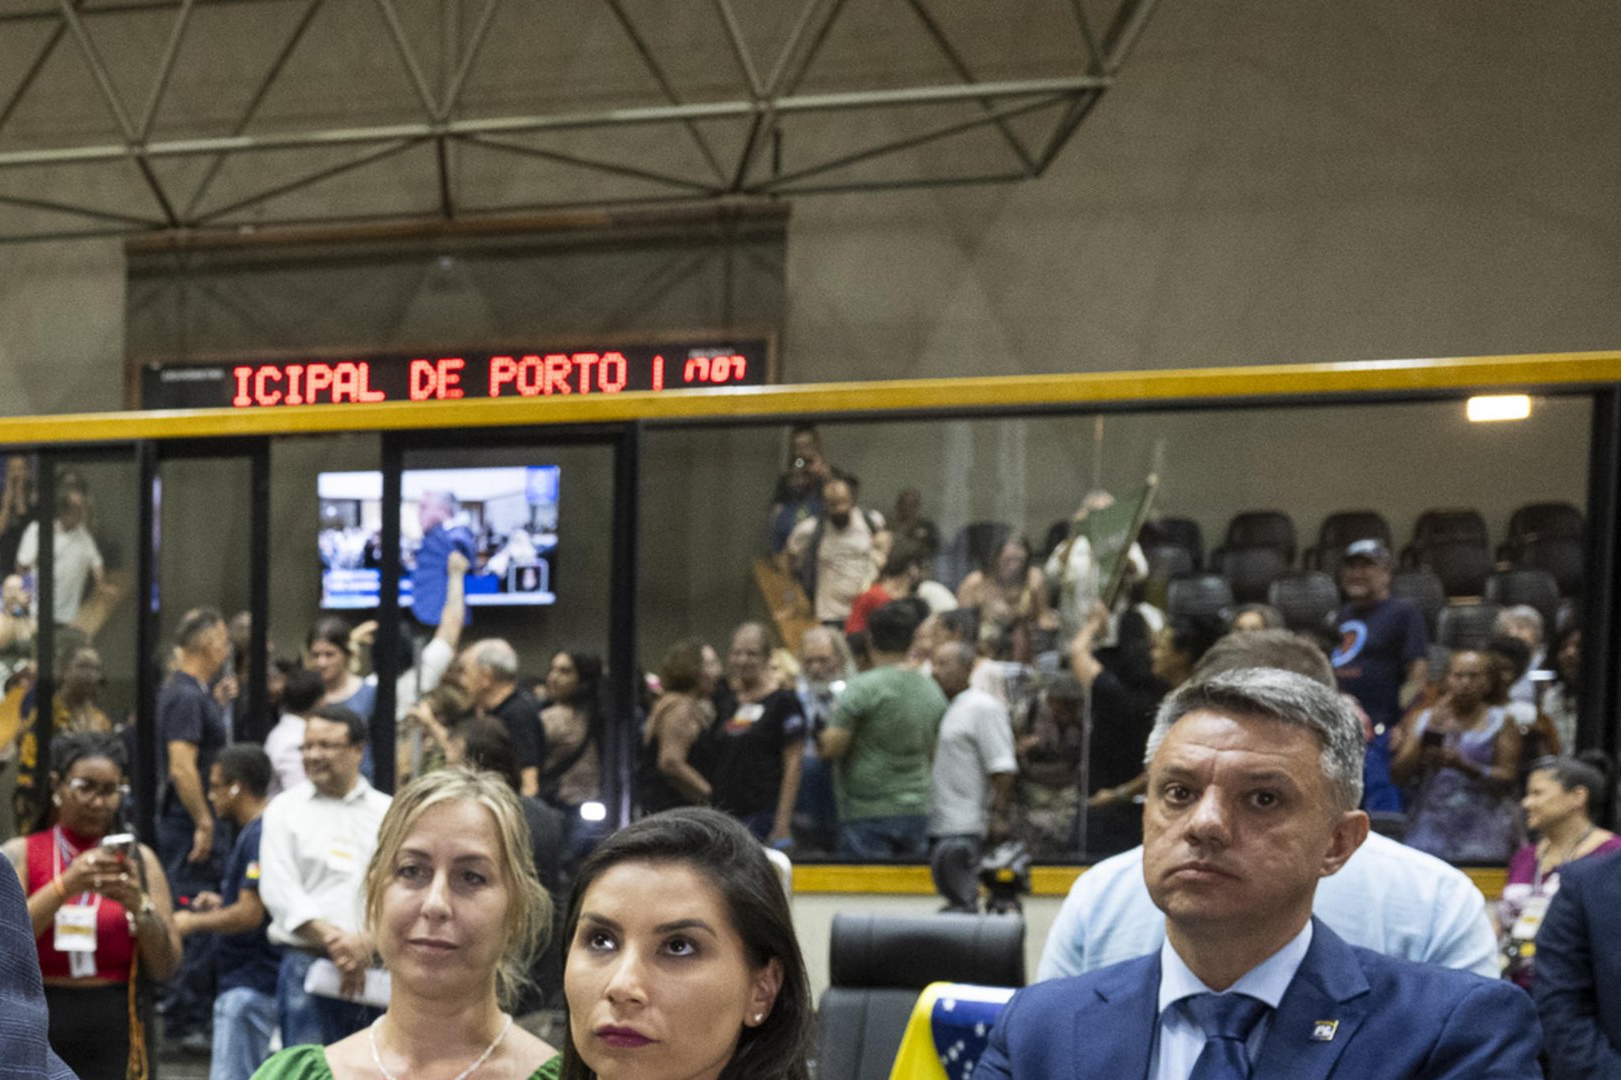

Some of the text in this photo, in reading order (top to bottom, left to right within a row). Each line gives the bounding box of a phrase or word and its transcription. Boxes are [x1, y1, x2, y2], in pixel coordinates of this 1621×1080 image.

[233, 361, 386, 407] ICIPAL
[409, 357, 466, 401] DE
[489, 351, 628, 398] PORTO
